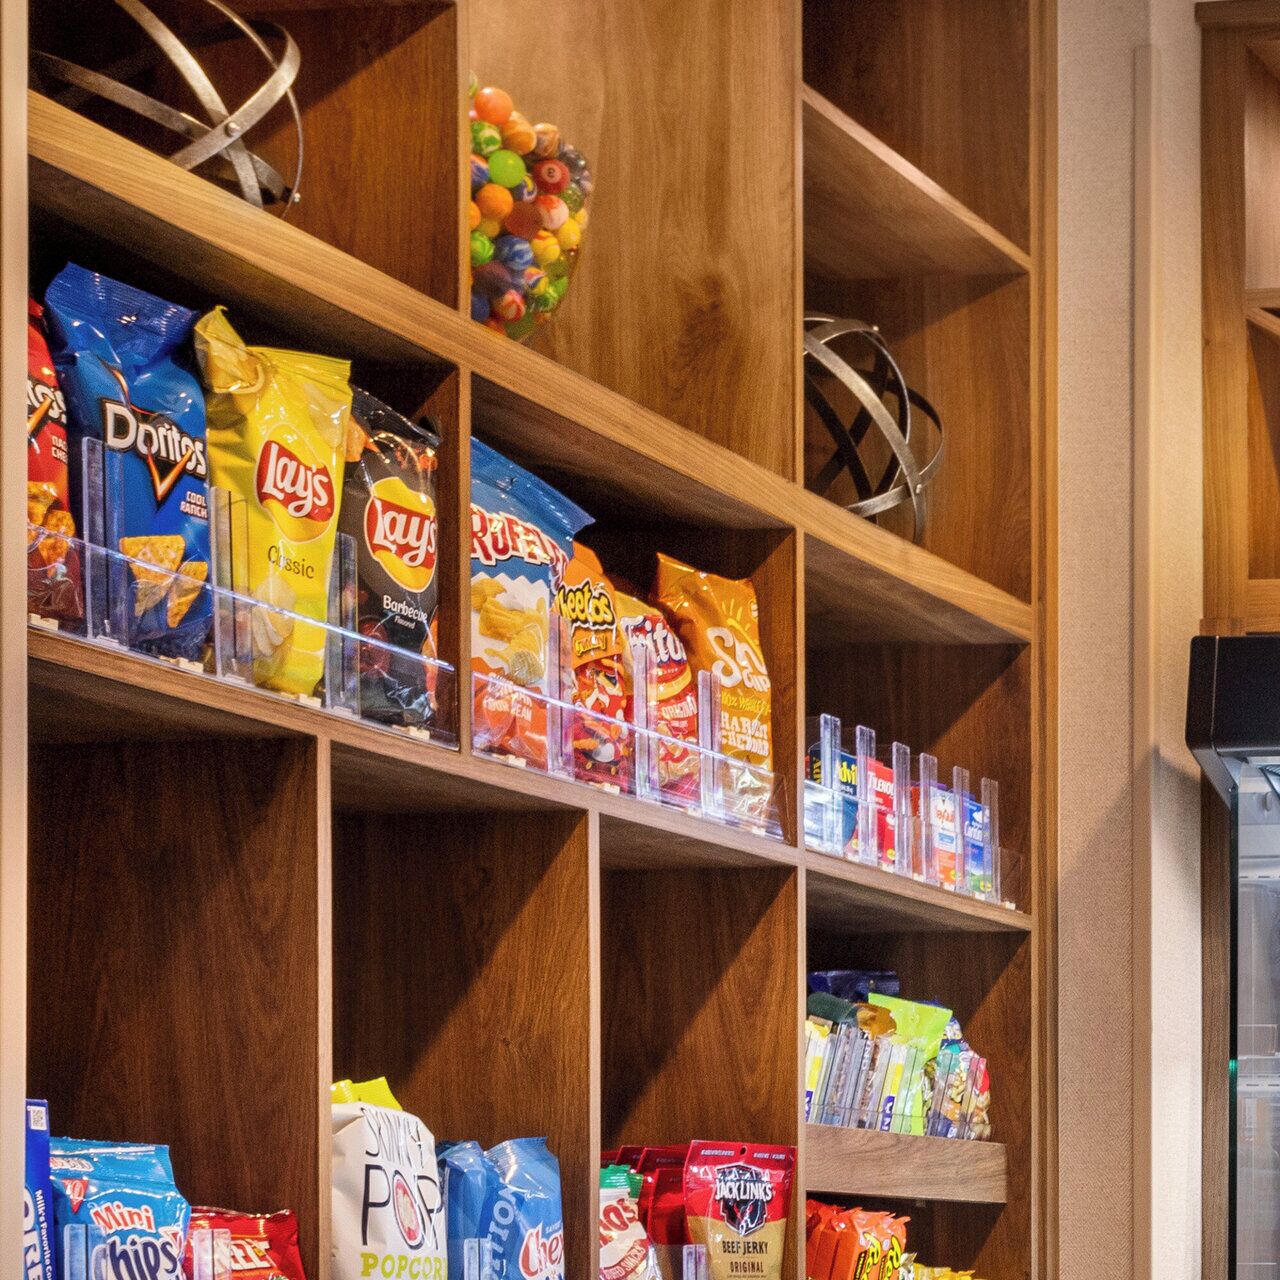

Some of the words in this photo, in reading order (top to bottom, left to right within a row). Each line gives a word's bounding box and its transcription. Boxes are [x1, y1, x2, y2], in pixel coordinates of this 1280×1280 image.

[105, 402, 207, 476] Doritos
[262, 442, 329, 518] Lay's
[180, 500, 208, 519] RANCH
[185, 490, 206, 506] COOL
[372, 498, 437, 567] Lay's
[383, 595, 428, 623] Barbecue
[558, 584, 613, 623] heetos
[361, 1106, 426, 1170] SKINNY
[360, 1164, 445, 1251] POP
[716, 1180, 740, 1201] JACK
[740, 1180, 773, 1201] LINK'S
[91, 1202, 155, 1232] Mini
[39, 1222, 51, 1264] Favorite
[722, 1241, 741, 1254] BEEF
[742, 1241, 768, 1254] JERKY
[730, 1261, 764, 1273] ORIGINAL
